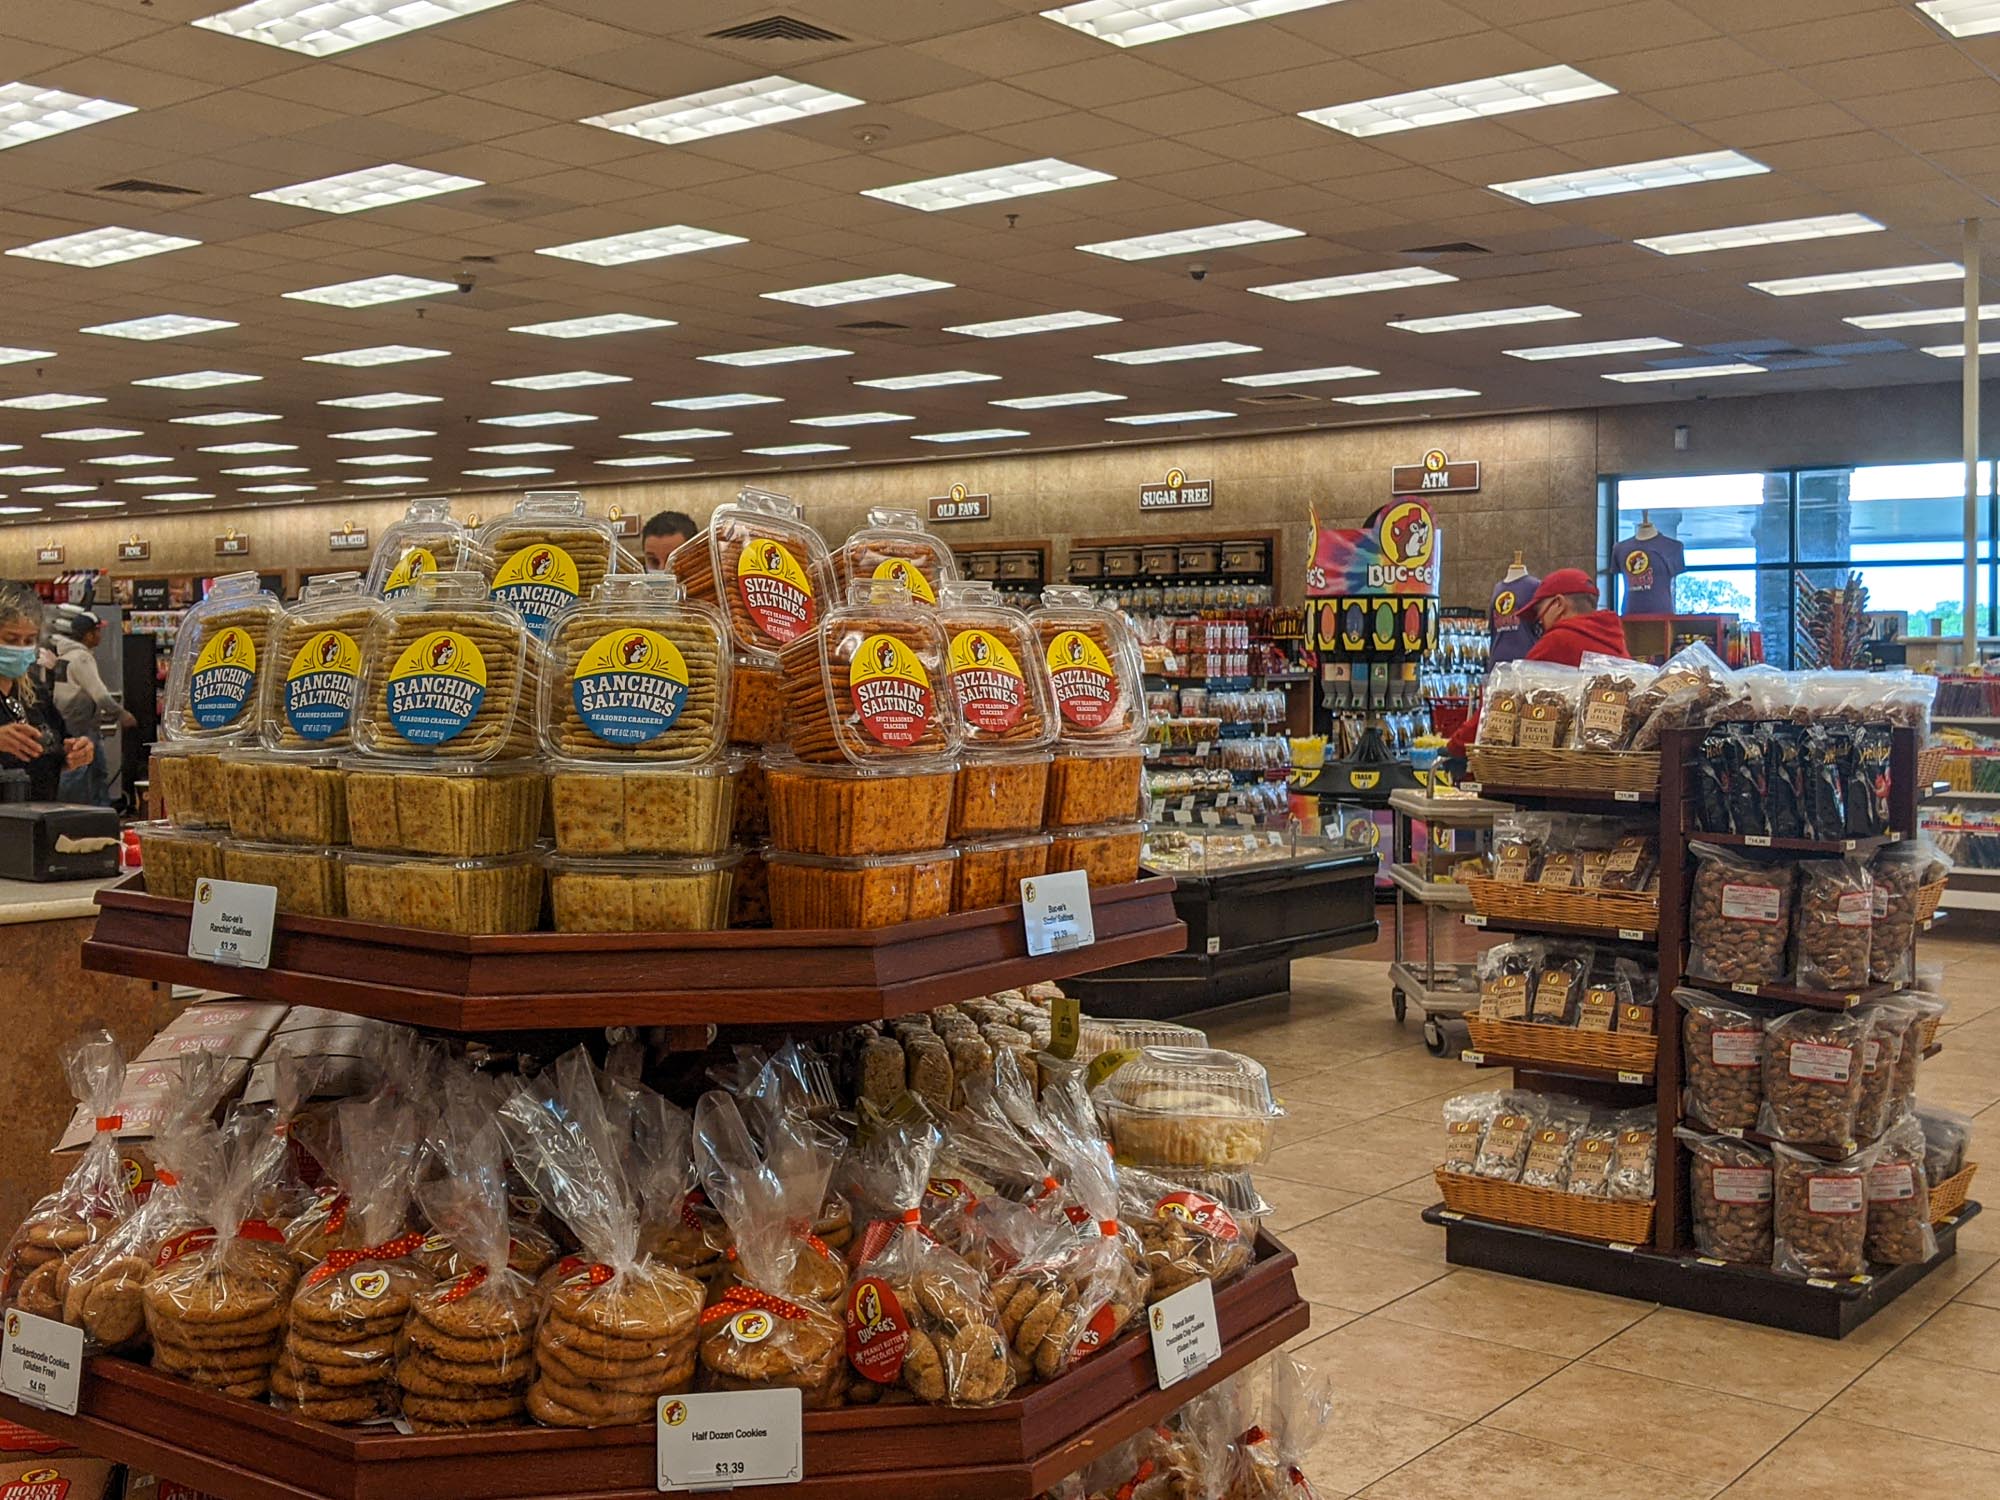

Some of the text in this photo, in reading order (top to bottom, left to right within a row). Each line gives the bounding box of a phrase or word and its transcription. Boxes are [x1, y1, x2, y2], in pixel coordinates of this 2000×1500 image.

[1421, 472, 1449, 489] ATM
[1142, 488, 1209, 506] SUGAR FREE
[937, 502, 980, 517] OLD FAVS
[744, 577, 808, 606] SIZZLIN'
[747, 593, 806, 621] SALTINES
[196, 668, 252, 690] RANCHIN'
[291, 674, 354, 696] RANCHIN
[393, 677, 480, 701] RANCHIN'
[580, 674, 683, 700] RANCHIN'
[953, 671, 1018, 691] SIZZLIN'
[1053, 670, 1110, 689] SIZZLIN'
[194, 683, 246, 703] SALTINES
[290, 690, 352, 711] SALTINES
[857, 680, 926, 702] SIZZLIN'
[960, 686, 1018, 706] SALTINES
[1058, 685, 1110, 702] SALTINES
[392, 694, 473, 718] SALTINES
[581, 692, 676, 717] SALTINES
[862, 697, 925, 718] SALTINES
[399, 715, 461, 725] SEASONED CRACKERS
[591, 714, 627, 722] SEASONED
[221, 913, 244, 924] Buc-ee's
[209, 922, 252, 937] Ranchin' Saltines
[12, 1343, 70, 1370] Snickerdoodle Cookies
[863, 1343, 884, 1356] PEANUT
[864, 1349, 895, 1365] CHOCOLATE
[23, 1360, 57, 1380] (Gluten Free)
[691, 1428, 768, 1441] Half Dozen Cookies
[715, 1461, 745, 1476] $3.39
[5, 1484, 62, 1497] HOUSE
